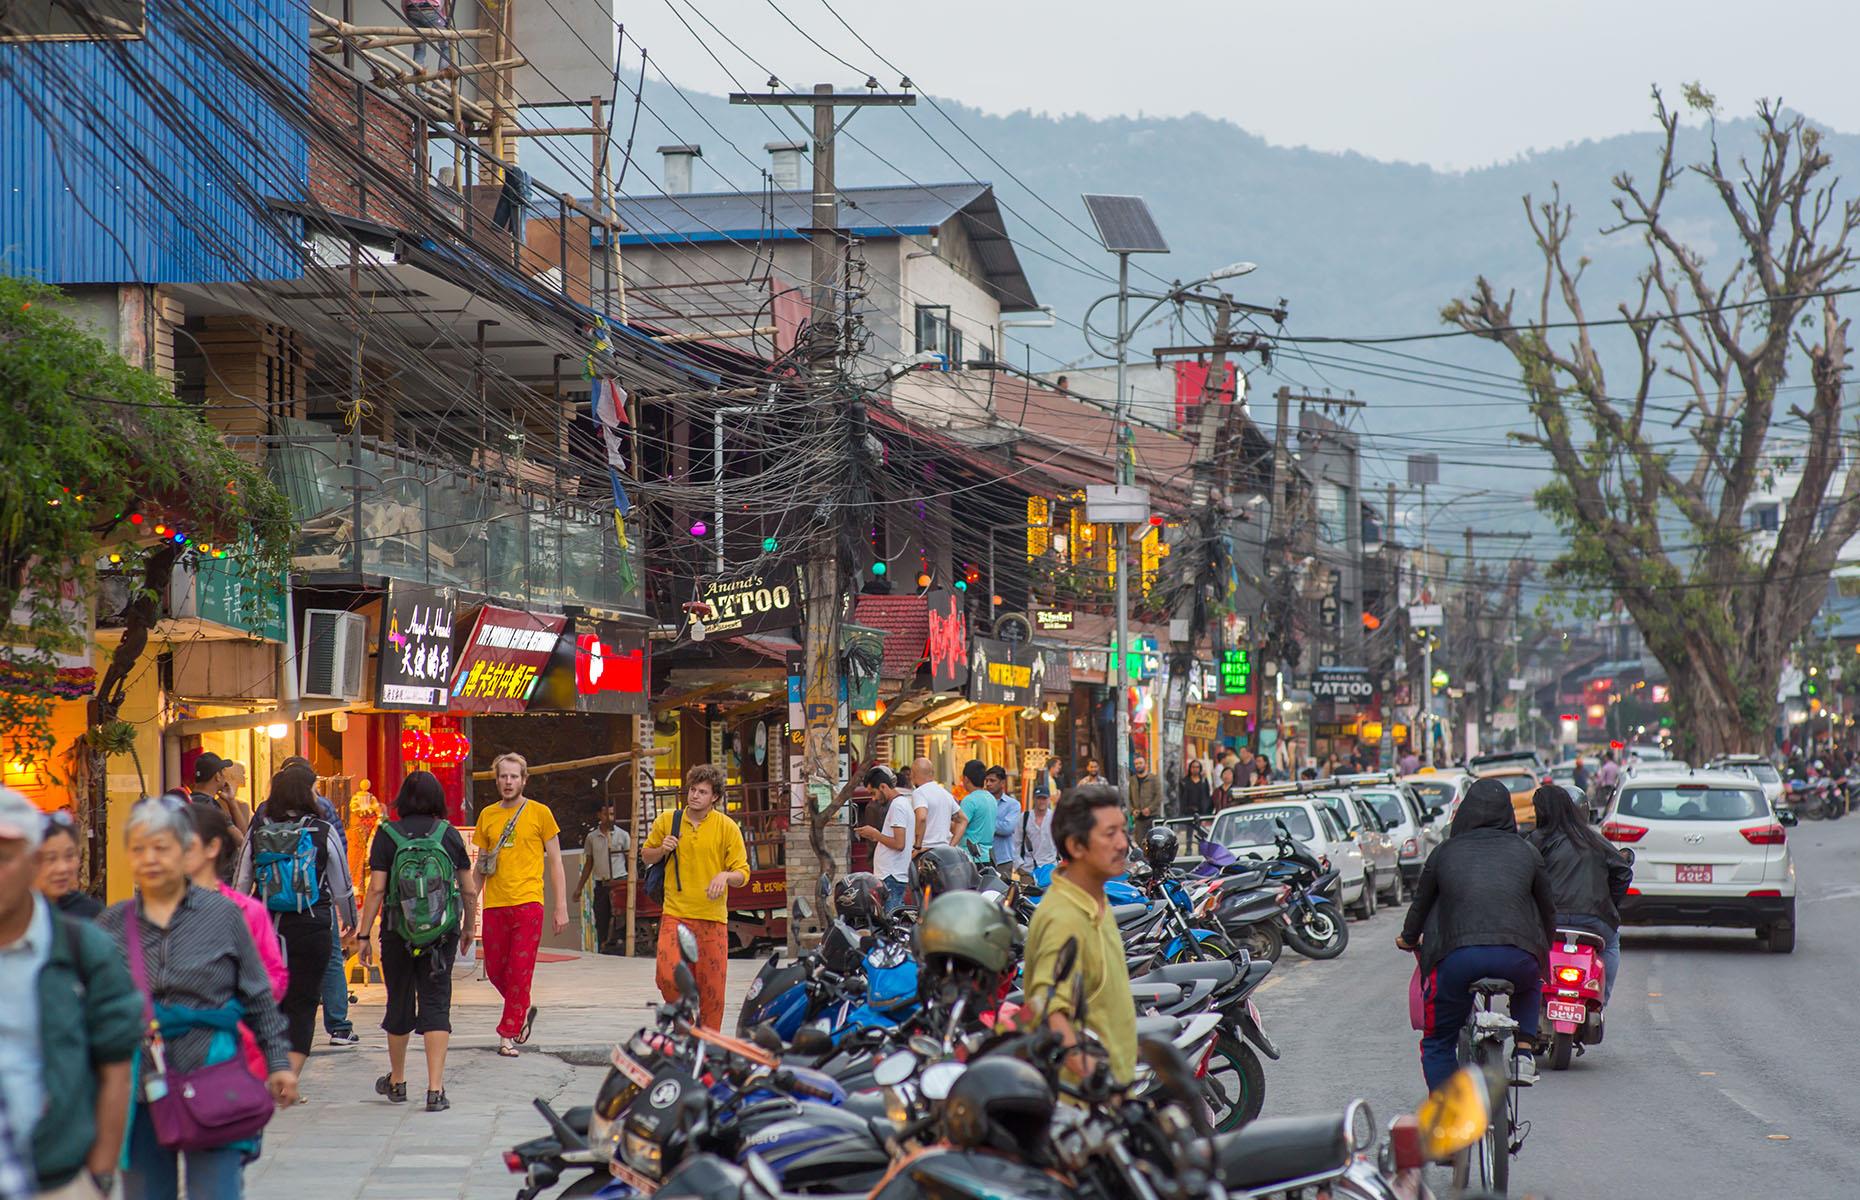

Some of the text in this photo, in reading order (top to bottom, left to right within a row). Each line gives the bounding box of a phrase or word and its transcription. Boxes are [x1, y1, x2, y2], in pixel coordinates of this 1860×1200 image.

[703, 575, 763, 597] Anand's
[400, 643, 450, 683] 天使的手
[1224, 651, 1247, 662] THE
[1221, 662, 1251, 675] IRISH
[1224, 675, 1247, 687] PUB
[1311, 682, 1373, 696] TATTOO
[1234, 811, 1290, 824] SUZUKI
